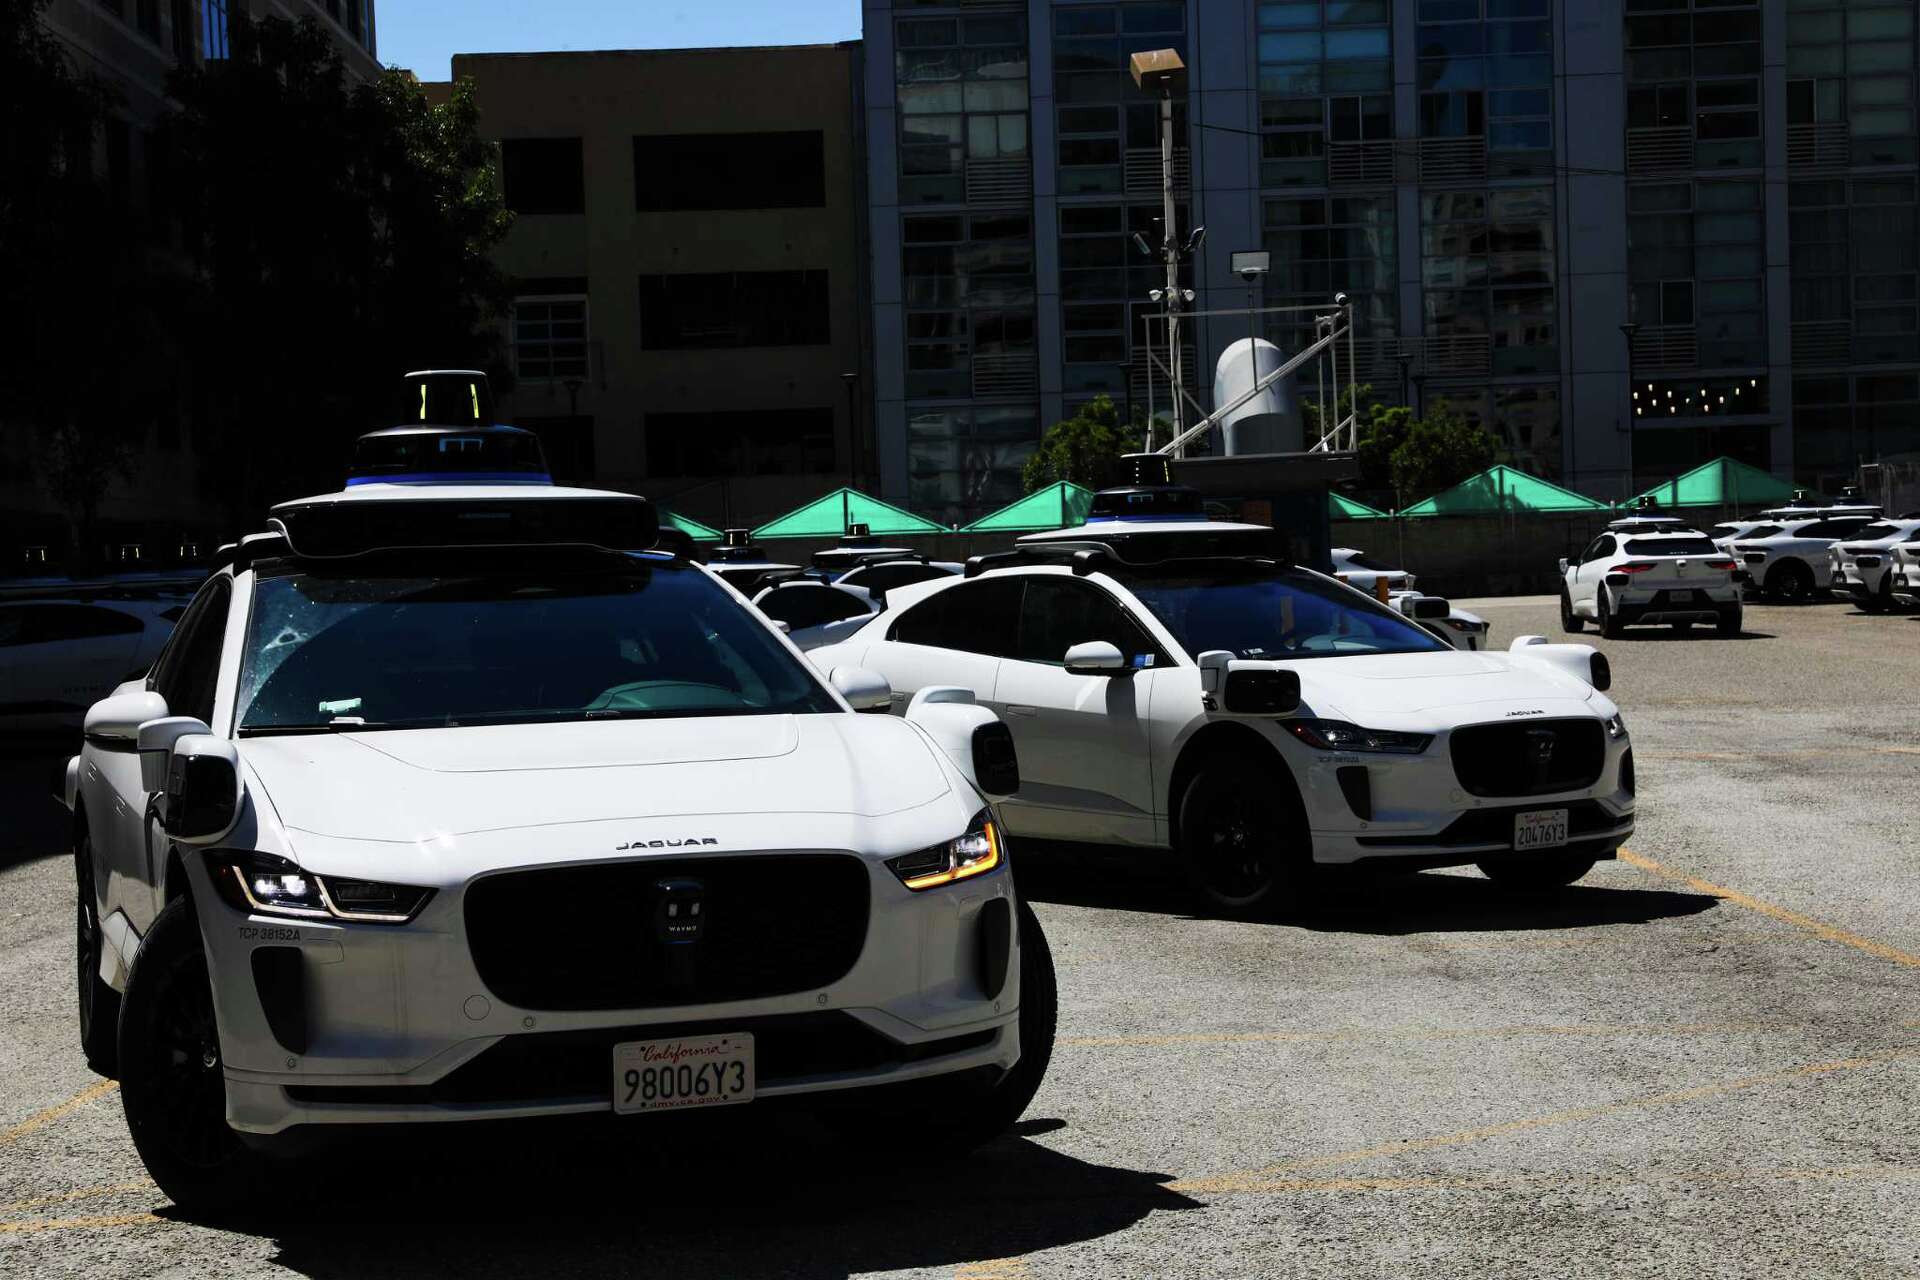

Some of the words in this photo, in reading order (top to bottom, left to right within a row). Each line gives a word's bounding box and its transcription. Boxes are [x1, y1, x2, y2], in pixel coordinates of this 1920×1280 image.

[1505, 709, 1545, 717] JAGUAR
[1518, 823, 1565, 845] 20476Y3
[616, 837, 719, 850] JAGUAR
[240, 927, 259, 939] TCP
[260, 927, 301, 941] 38152A
[642, 1043, 726, 1064] California
[624, 1061, 745, 1103] 98006Y3
